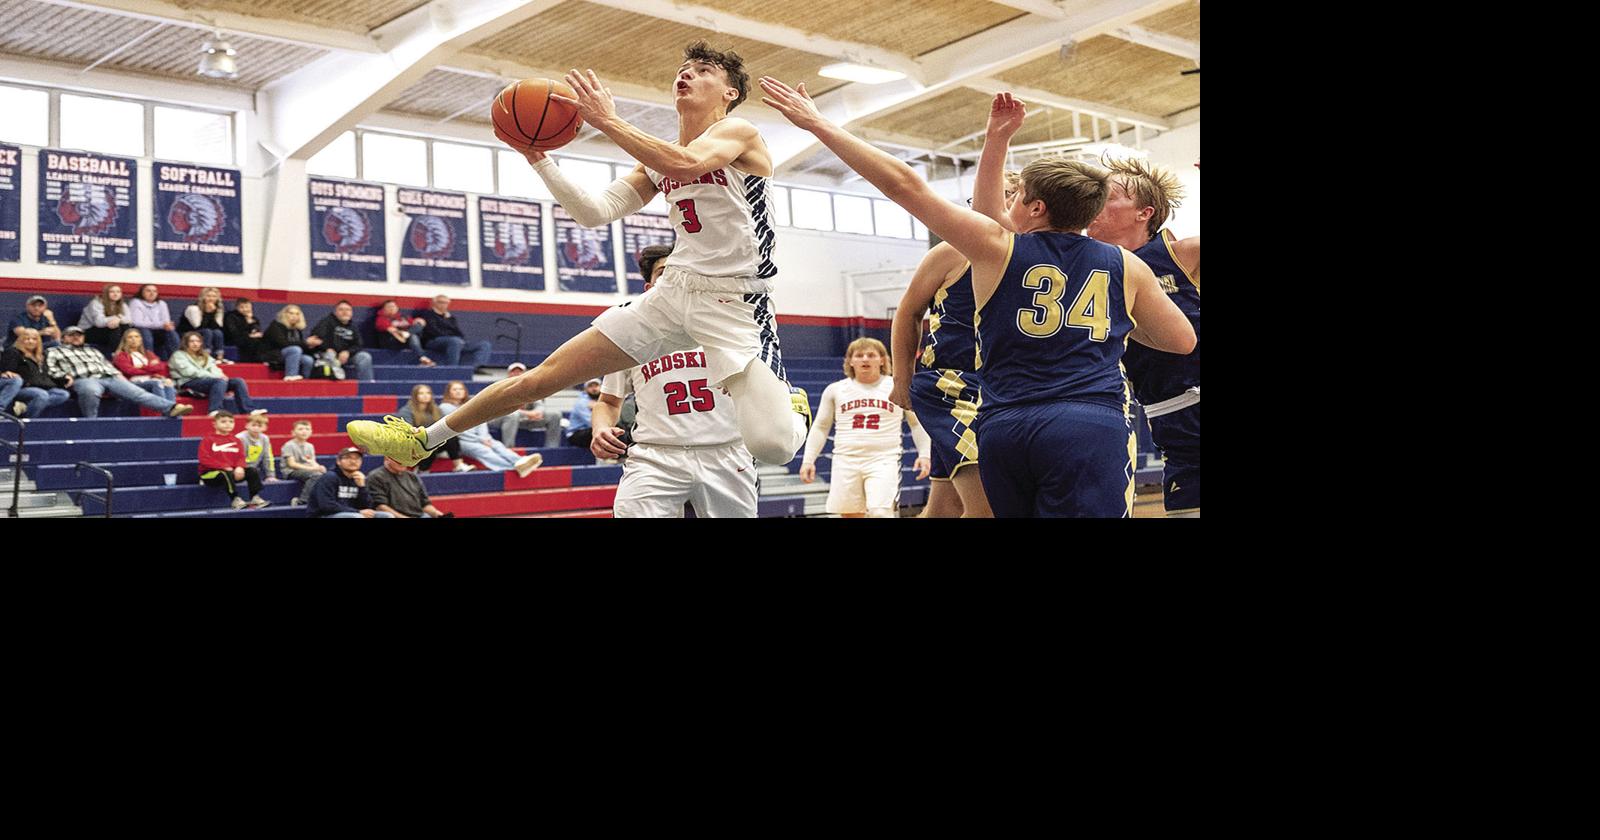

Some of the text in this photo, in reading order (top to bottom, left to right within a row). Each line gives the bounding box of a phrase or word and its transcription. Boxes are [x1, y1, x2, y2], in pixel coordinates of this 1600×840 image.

[47, 153, 130, 177] BASEBALL
[160, 166, 235, 187] SOFTBALL
[676, 198, 702, 233] 3
[1016, 264, 1111, 342] 34
[641, 351, 707, 384] REDSKI
[663, 378, 715, 416] 25
[840, 398, 895, 414] REDSKINS
[852, 413, 881, 430] 22
